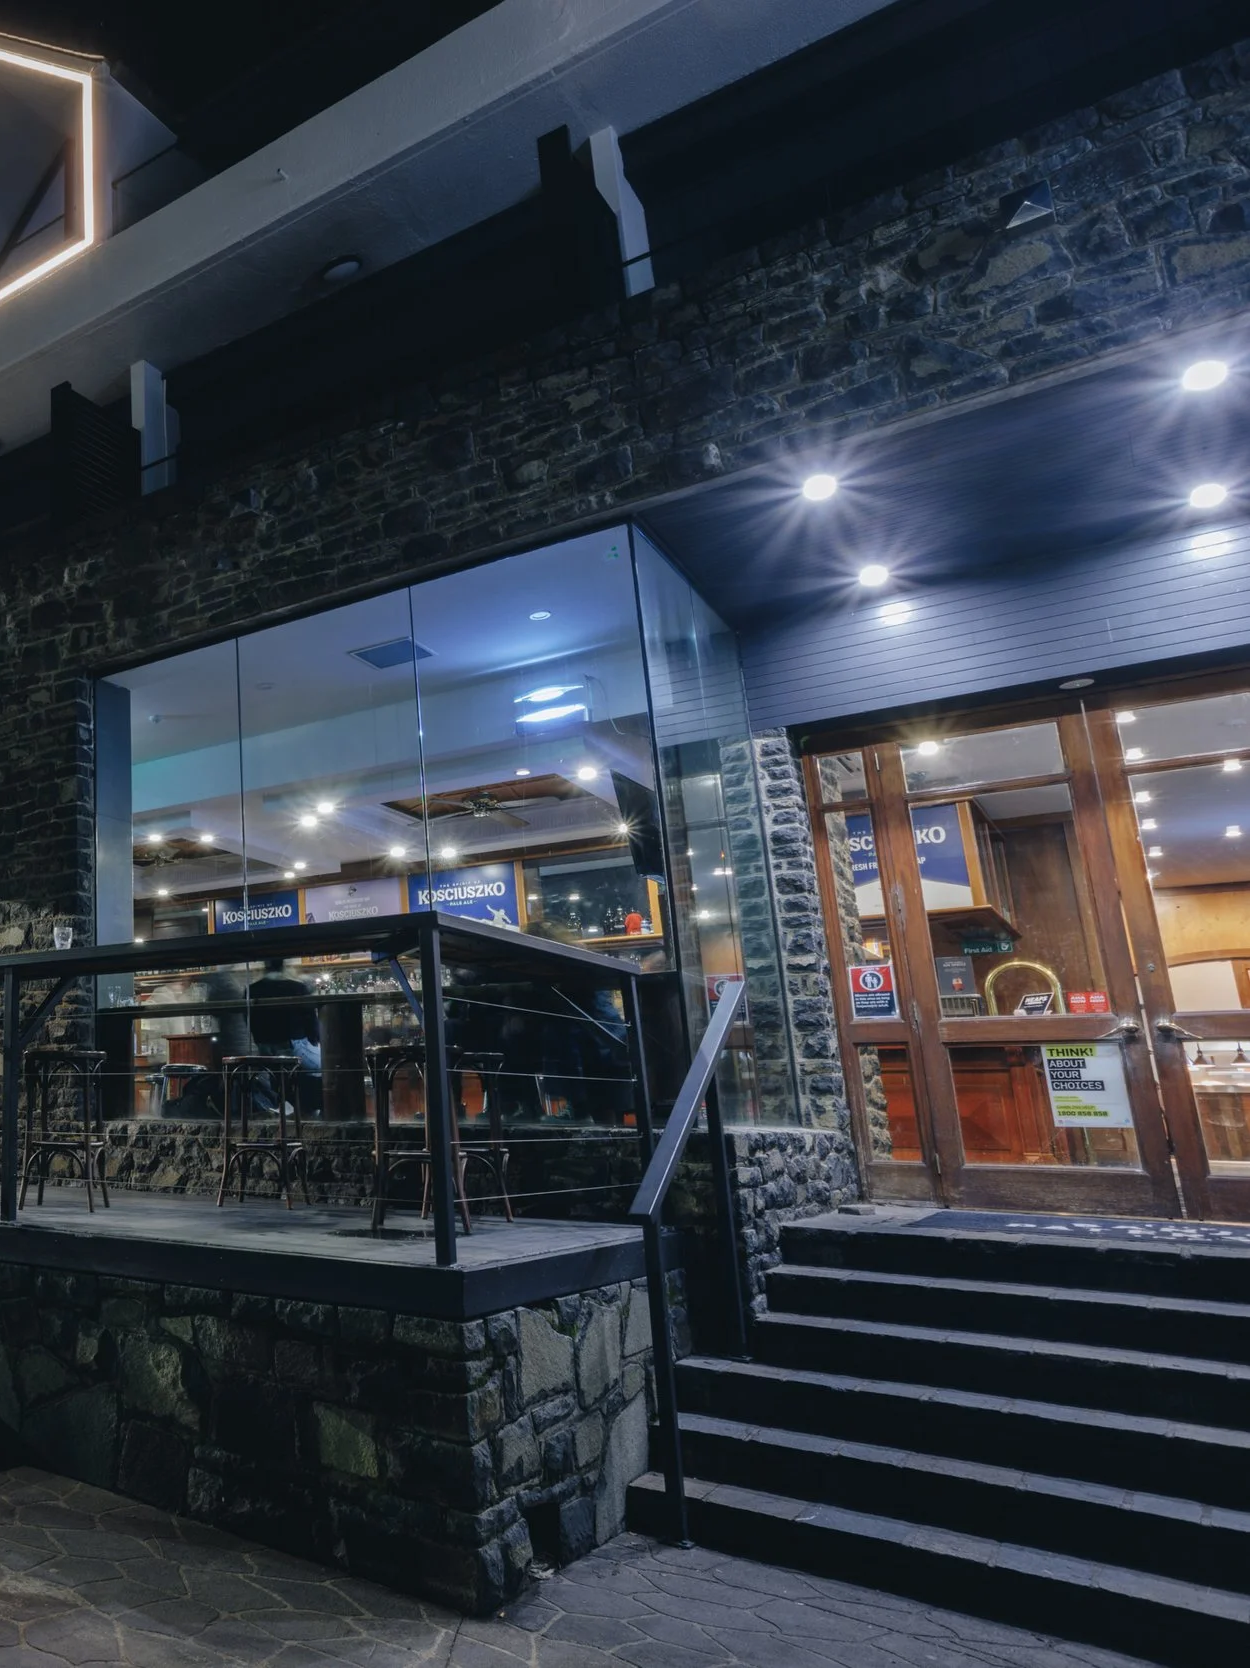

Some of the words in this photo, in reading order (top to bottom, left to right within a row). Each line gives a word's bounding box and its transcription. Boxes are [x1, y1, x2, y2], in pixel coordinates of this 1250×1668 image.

[418, 882, 505, 905] KOSCIUSZKO
[222, 904, 292, 925] KOSCIUSZKO
[1046, 1047, 1094, 1057] THINK!
[1049, 1059, 1085, 1068] ABOUT
[1050, 1070, 1080, 1079] YOUR
[1052, 1081, 1103, 1090] CHOICES
